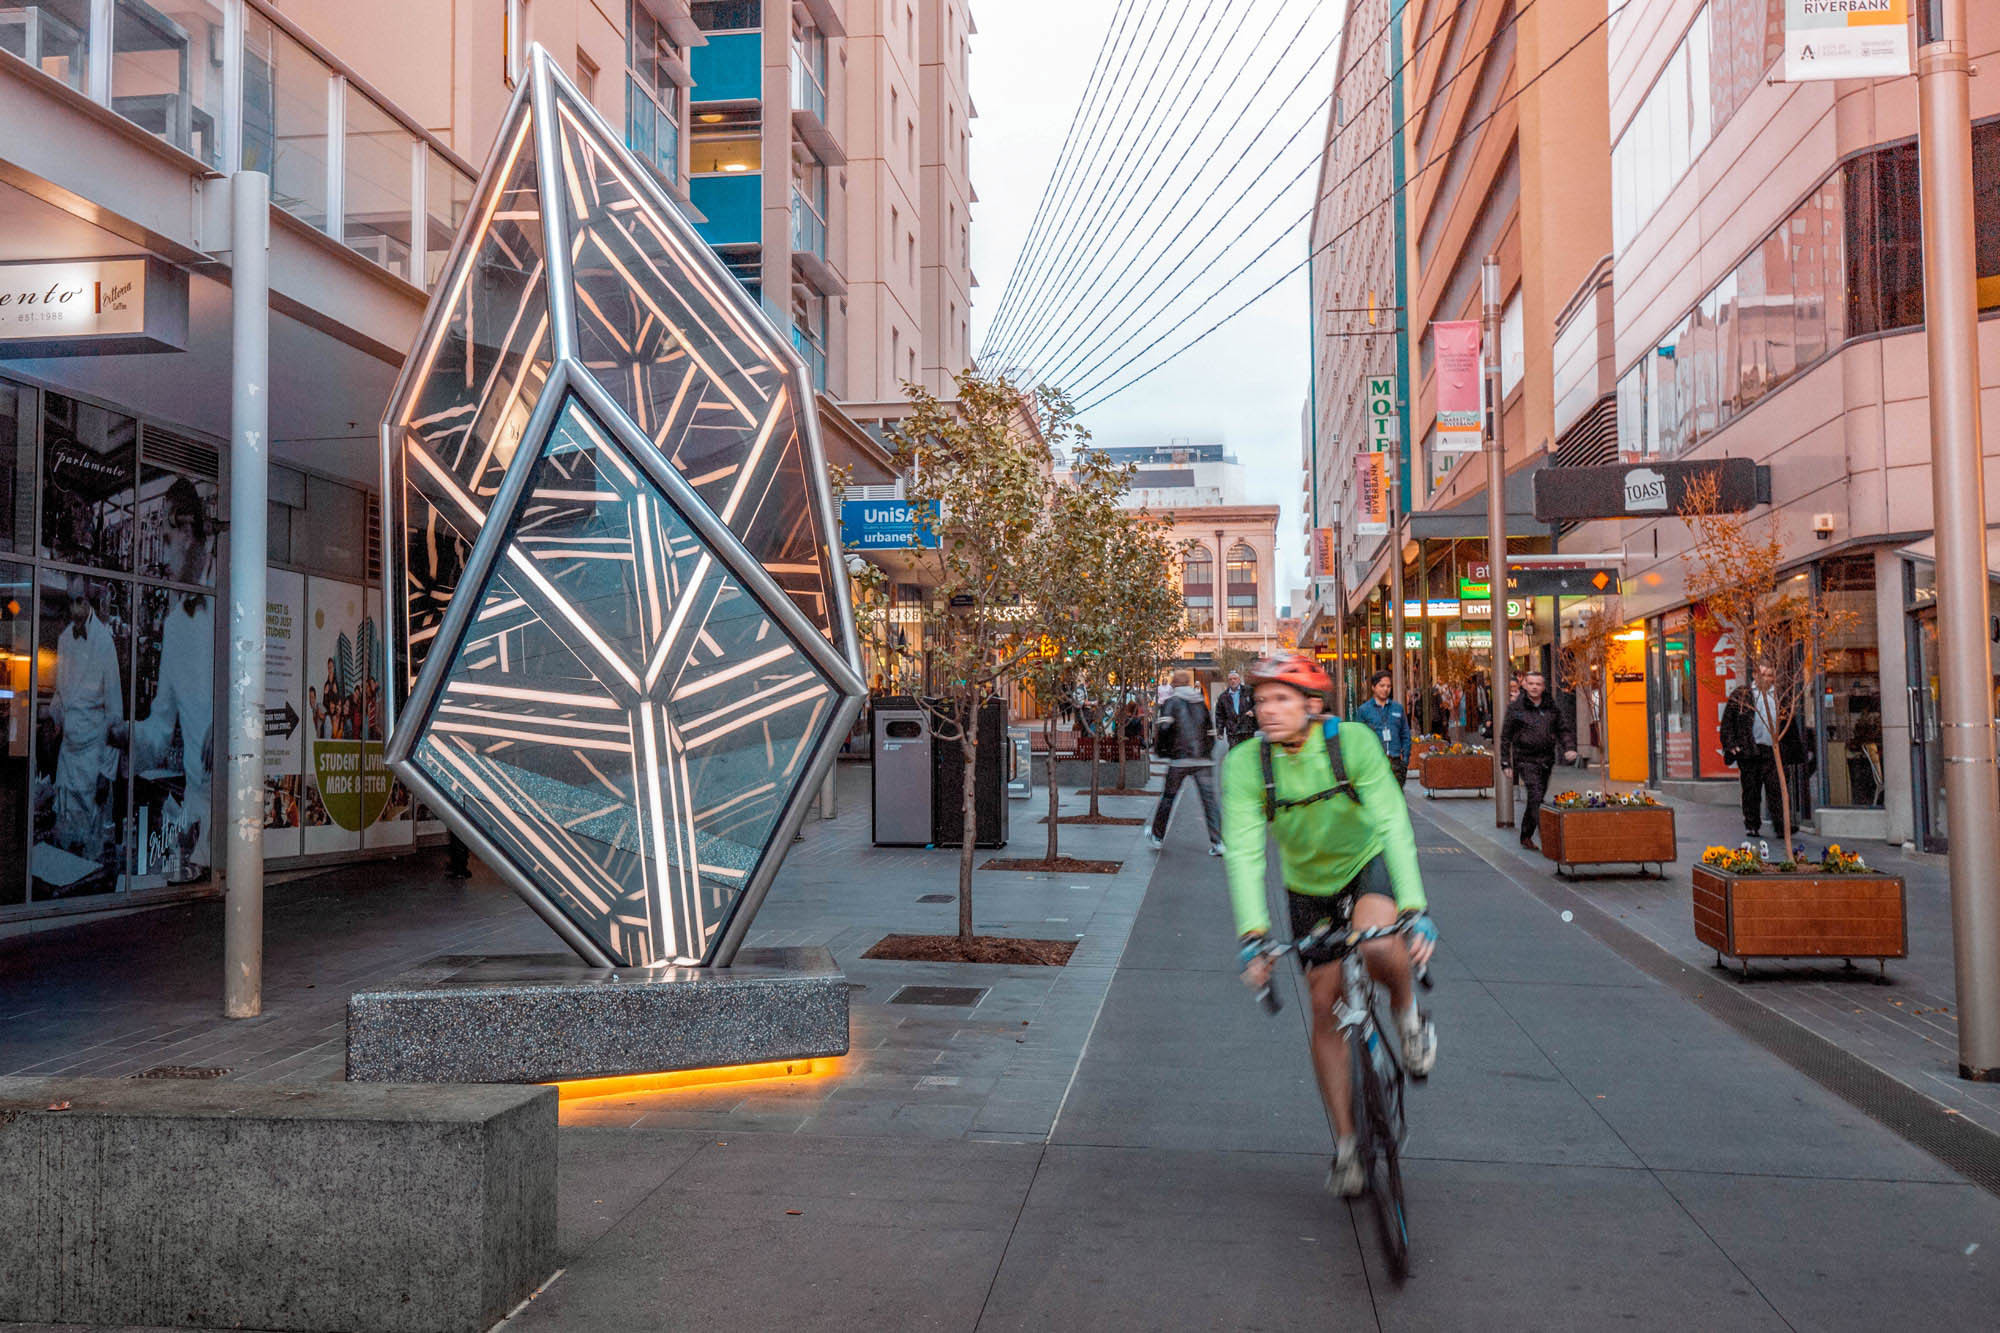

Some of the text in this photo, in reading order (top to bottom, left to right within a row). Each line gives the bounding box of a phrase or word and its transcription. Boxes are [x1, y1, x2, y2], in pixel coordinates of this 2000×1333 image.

[1804, 0, 1888, 14] RIVERBANK
[1371, 380, 1391, 453] MOTE
[1626, 480, 1665, 500] TOAST
[320, 753, 387, 771] STUDENT LIVIN
[326, 776, 386, 794] MADE BETTER
